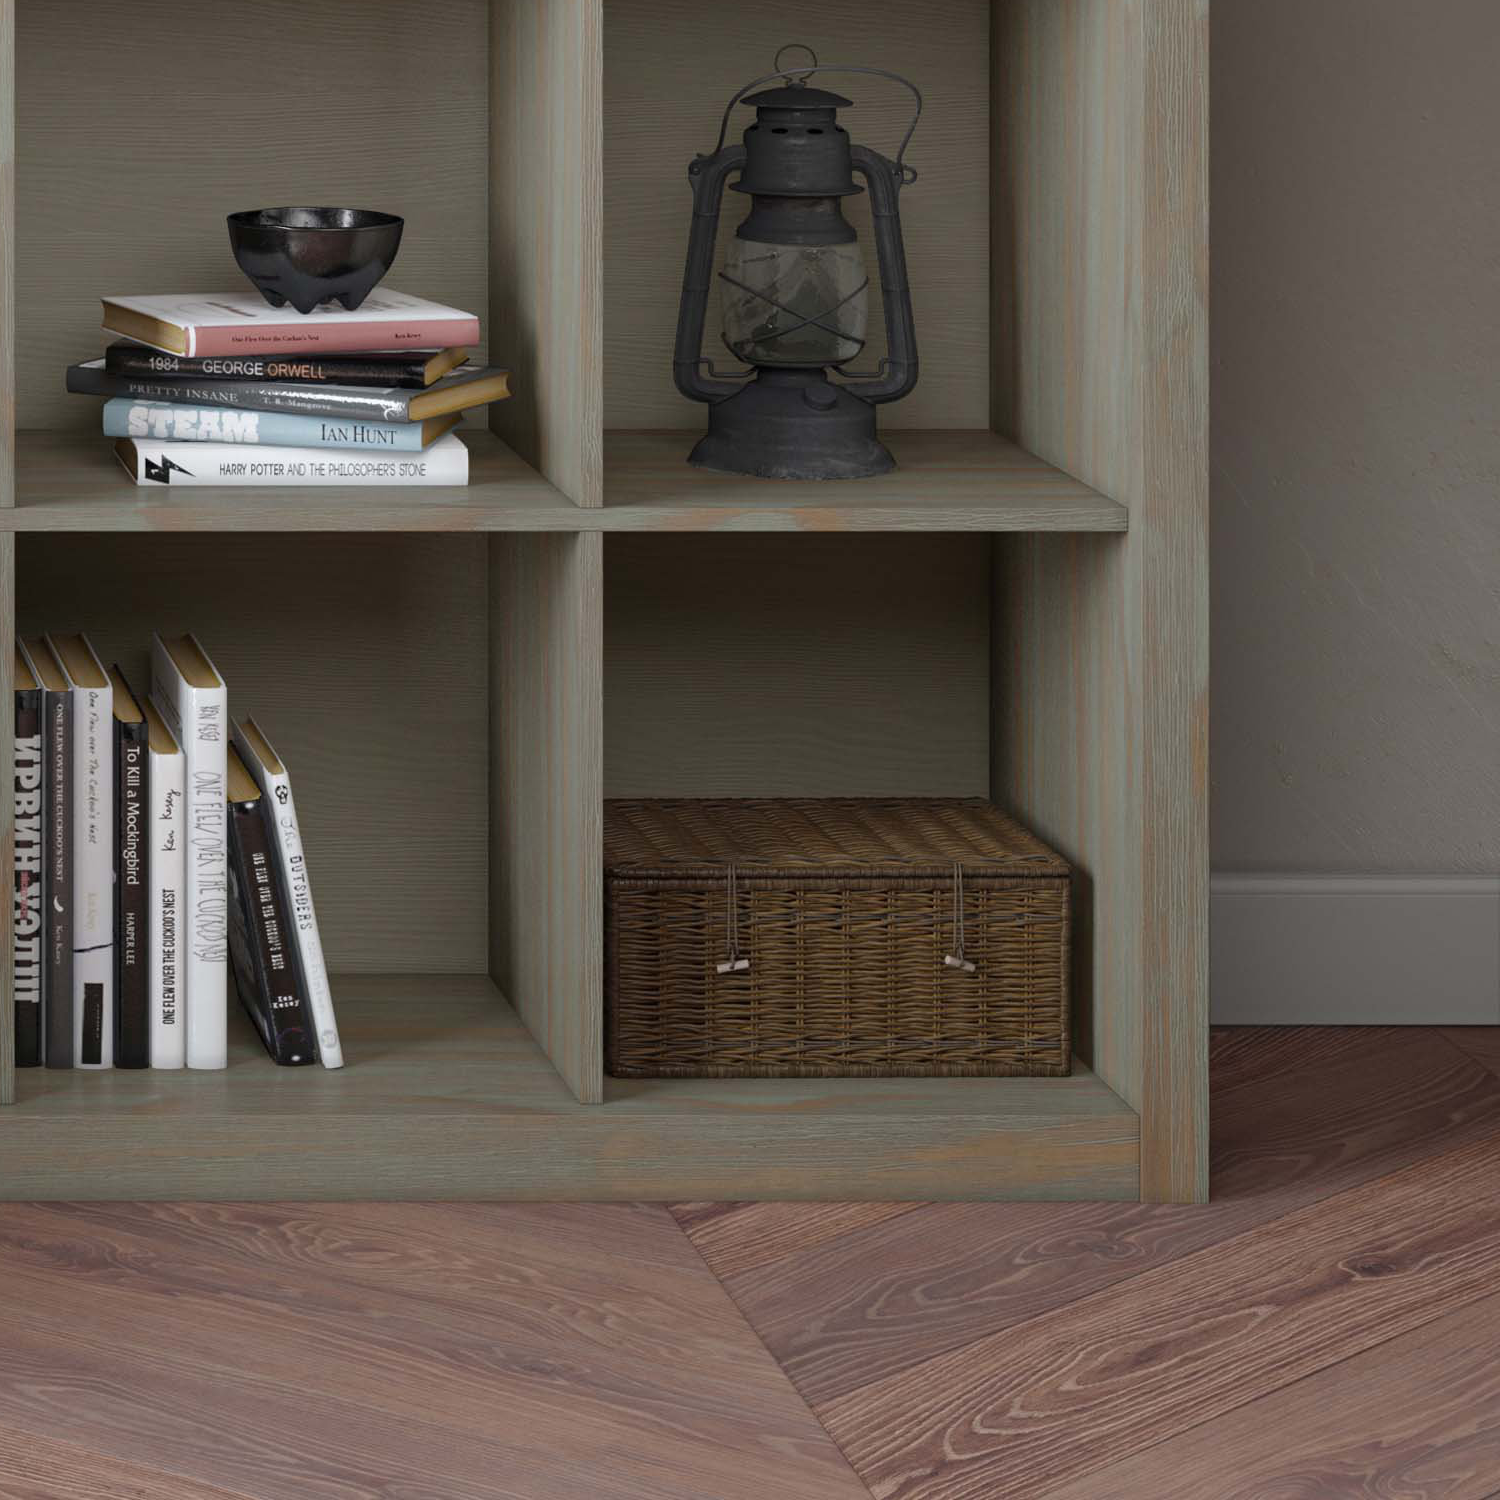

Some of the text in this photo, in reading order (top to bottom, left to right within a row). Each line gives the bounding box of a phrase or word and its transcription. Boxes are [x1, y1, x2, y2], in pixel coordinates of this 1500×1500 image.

[148, 356, 327, 380] 1984 GEORGE ORWELL
[129, 384, 181, 397] PRETTY
[186, 388, 238, 402] INSANE
[128, 405, 260, 443] STEAM
[219, 463, 426, 477] HARRY POTTER AND THE PHILOSOPHER'S STONE
[89, 691, 98, 708] One
[89, 736, 97, 754] over
[127, 746, 140, 763] To
[89, 758, 99, 775] The
[127, 766, 140, 786] Kill
[55, 703, 64, 882] ONE FLEW OVER THE CUCKOO'S NEST
[193, 771, 222, 797] ONE
[14, 734, 41, 873] ИРВИН
[193, 803, 224, 834] FLEW
[89, 824, 97, 845] Nest
[123, 802, 140, 885] Mockingbird
[191, 837, 225, 867] OVER
[197, 871, 226, 895] THE
[290, 855, 313, 931] OUTSIDERS
[159, 789, 181, 1025] ONE FLEW OVER THE CUCKOO'S NEST Ken Kesey
[125, 912, 135, 947] HARPER
[125, 949, 135, 965] LEE
